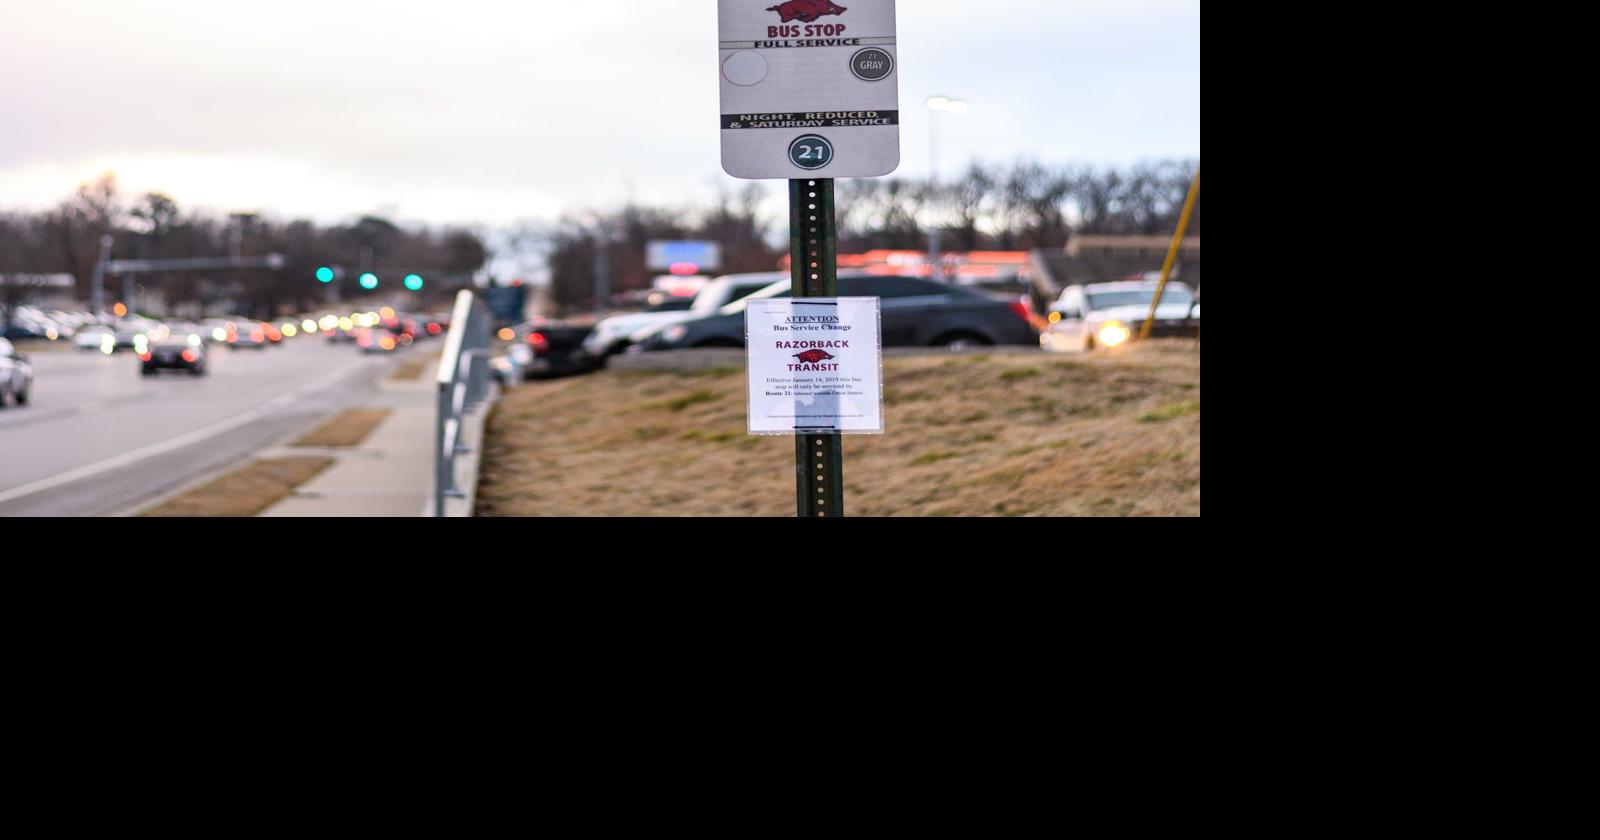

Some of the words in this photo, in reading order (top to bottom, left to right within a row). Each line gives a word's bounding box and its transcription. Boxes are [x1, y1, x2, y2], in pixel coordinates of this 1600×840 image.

[767, 25, 800, 38] BUS
[804, 23, 846, 37] STOP
[754, 40, 792, 48] FULL
[796, 38, 860, 47] SERVICE
[860, 60, 883, 70] GRAY
[740, 113, 796, 121] NIGHT,
[805, 111, 879, 120] REDUCED,
[749, 120, 824, 128] SATURDAY
[832, 118, 891, 126] SERVICE
[798, 145, 824, 160] 21
[776, 340, 849, 348] RAZORBACK
[787, 364, 839, 372] TRANSIT
